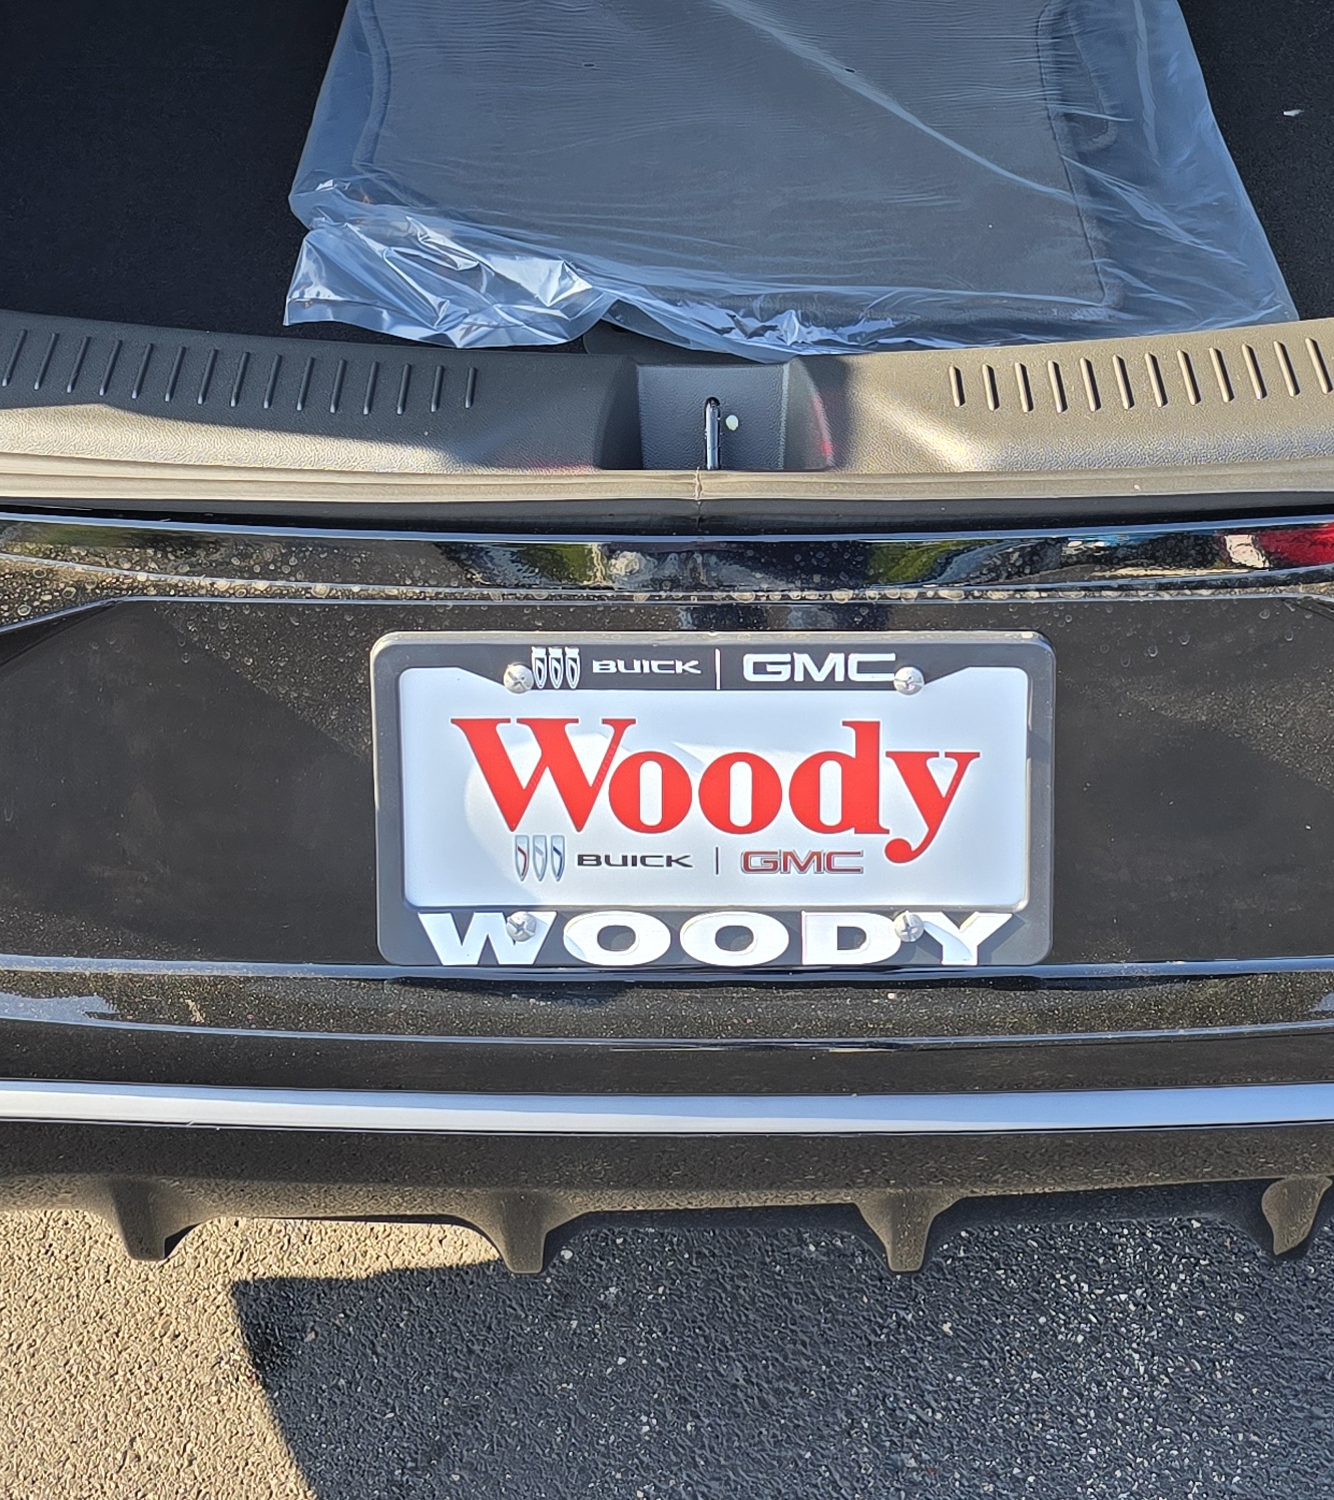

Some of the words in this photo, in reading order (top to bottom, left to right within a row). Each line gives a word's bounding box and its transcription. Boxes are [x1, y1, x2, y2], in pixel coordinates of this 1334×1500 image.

[592, 659, 702, 674] BUICK
[743, 652, 896, 682] GMC
[451, 717, 981, 864] Woody
[577, 853, 694, 868] BUICK
[741, 849, 864, 875] GMC
[417, 910, 1015, 966] WOODY
